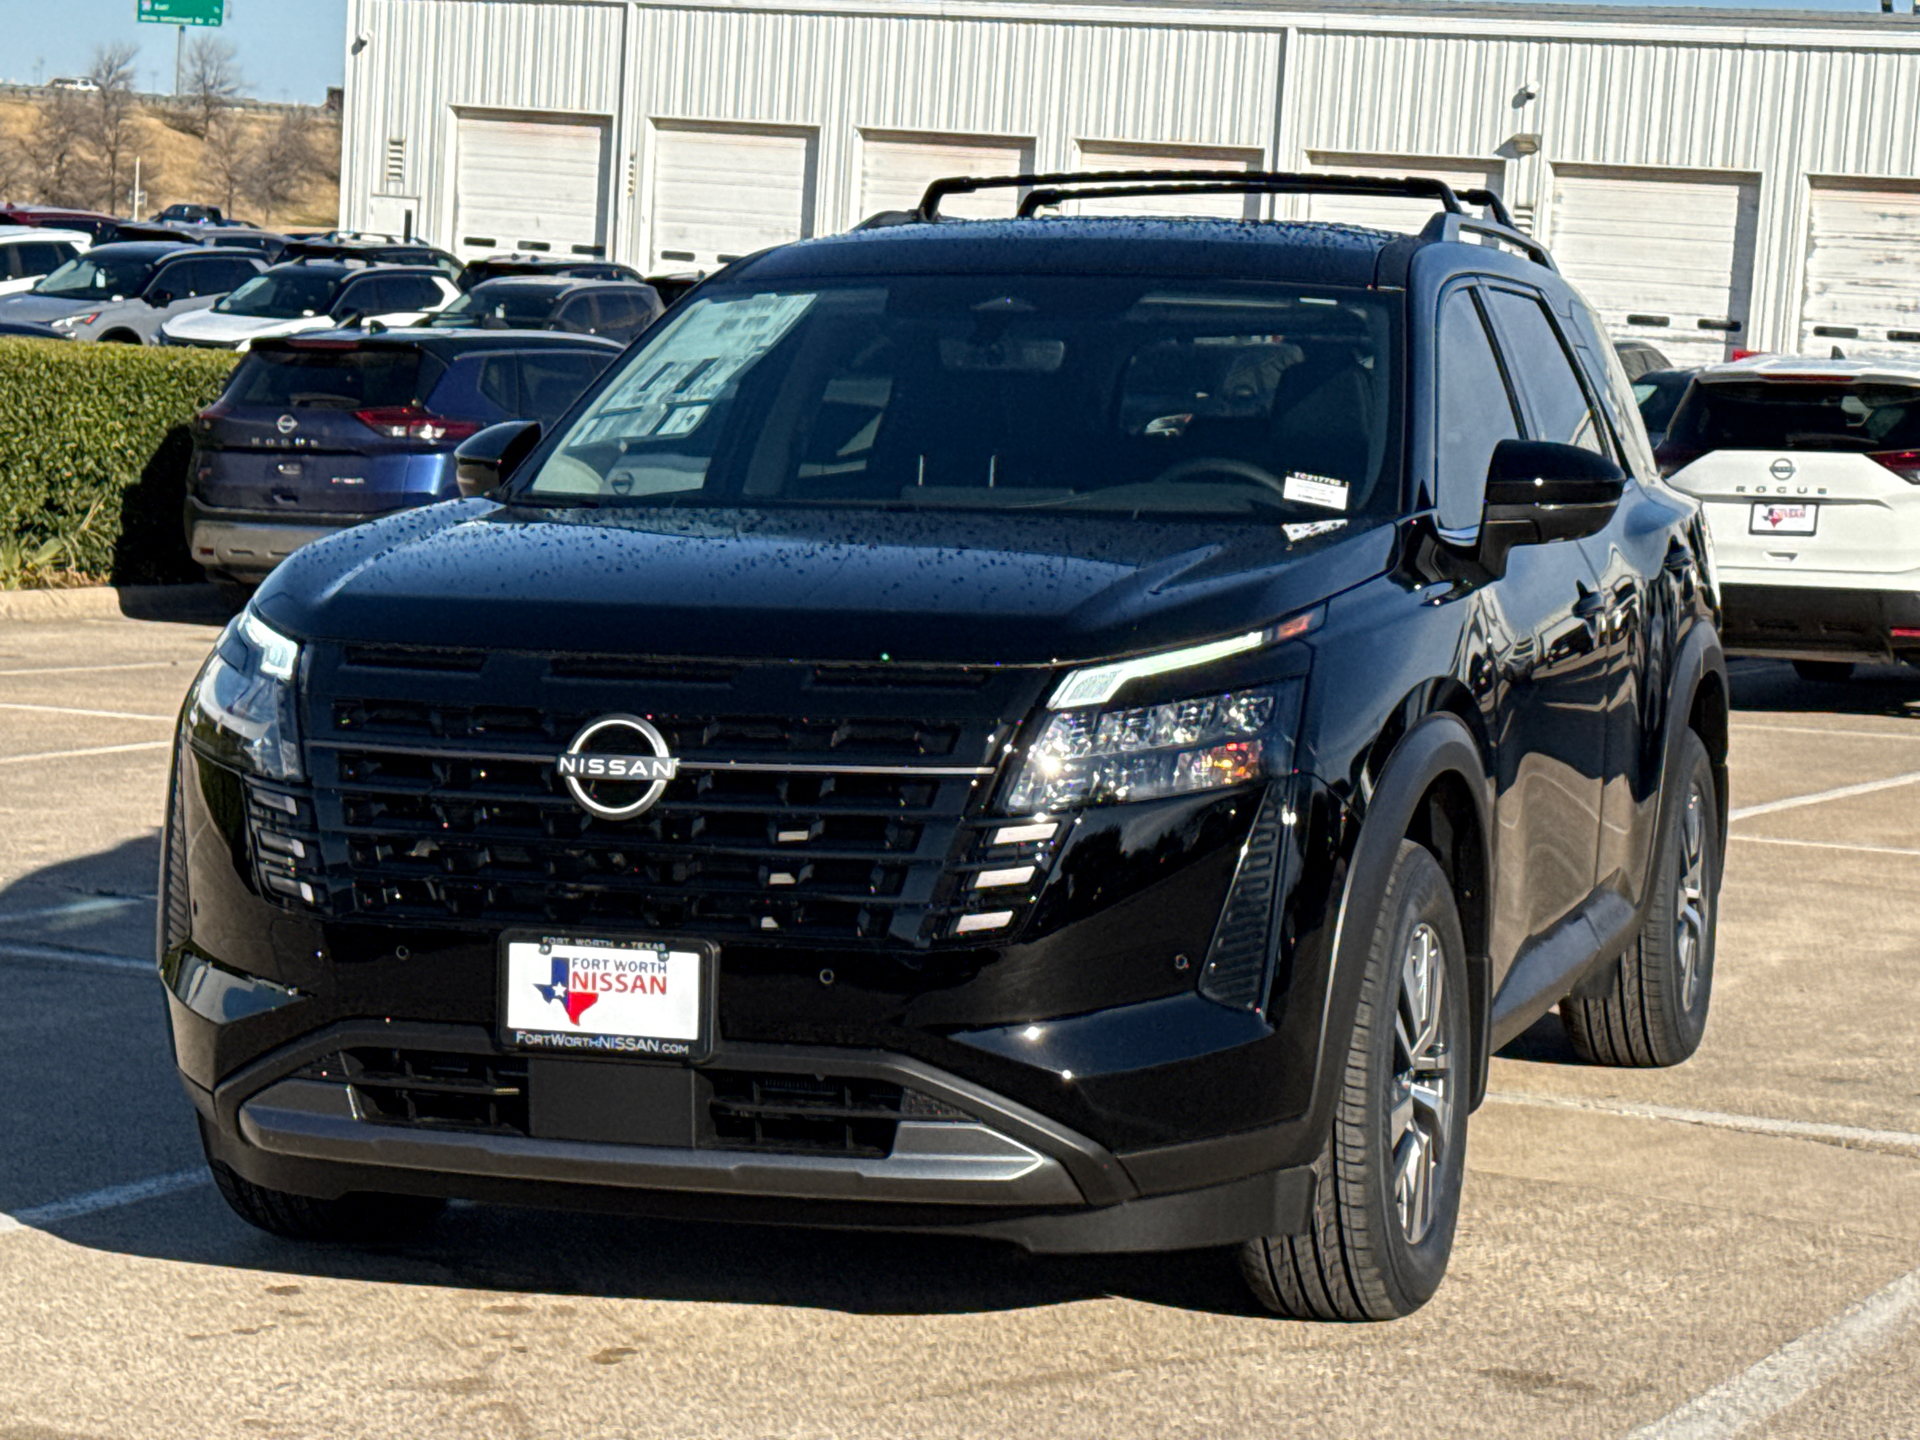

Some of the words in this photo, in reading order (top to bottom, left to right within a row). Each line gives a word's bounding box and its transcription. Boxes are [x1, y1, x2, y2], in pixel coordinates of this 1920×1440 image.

[1735, 485, 1827, 495] ROGUE
[559, 756, 672, 777] NISSAN
[542, 936, 570, 945] FORT
[575, 938, 614, 948] WORTH
[631, 941, 666, 951] TEXAS
[572, 957, 610, 971] FORT
[614, 959, 667, 974] WORTH
[571, 971, 667, 995] NISSAN
